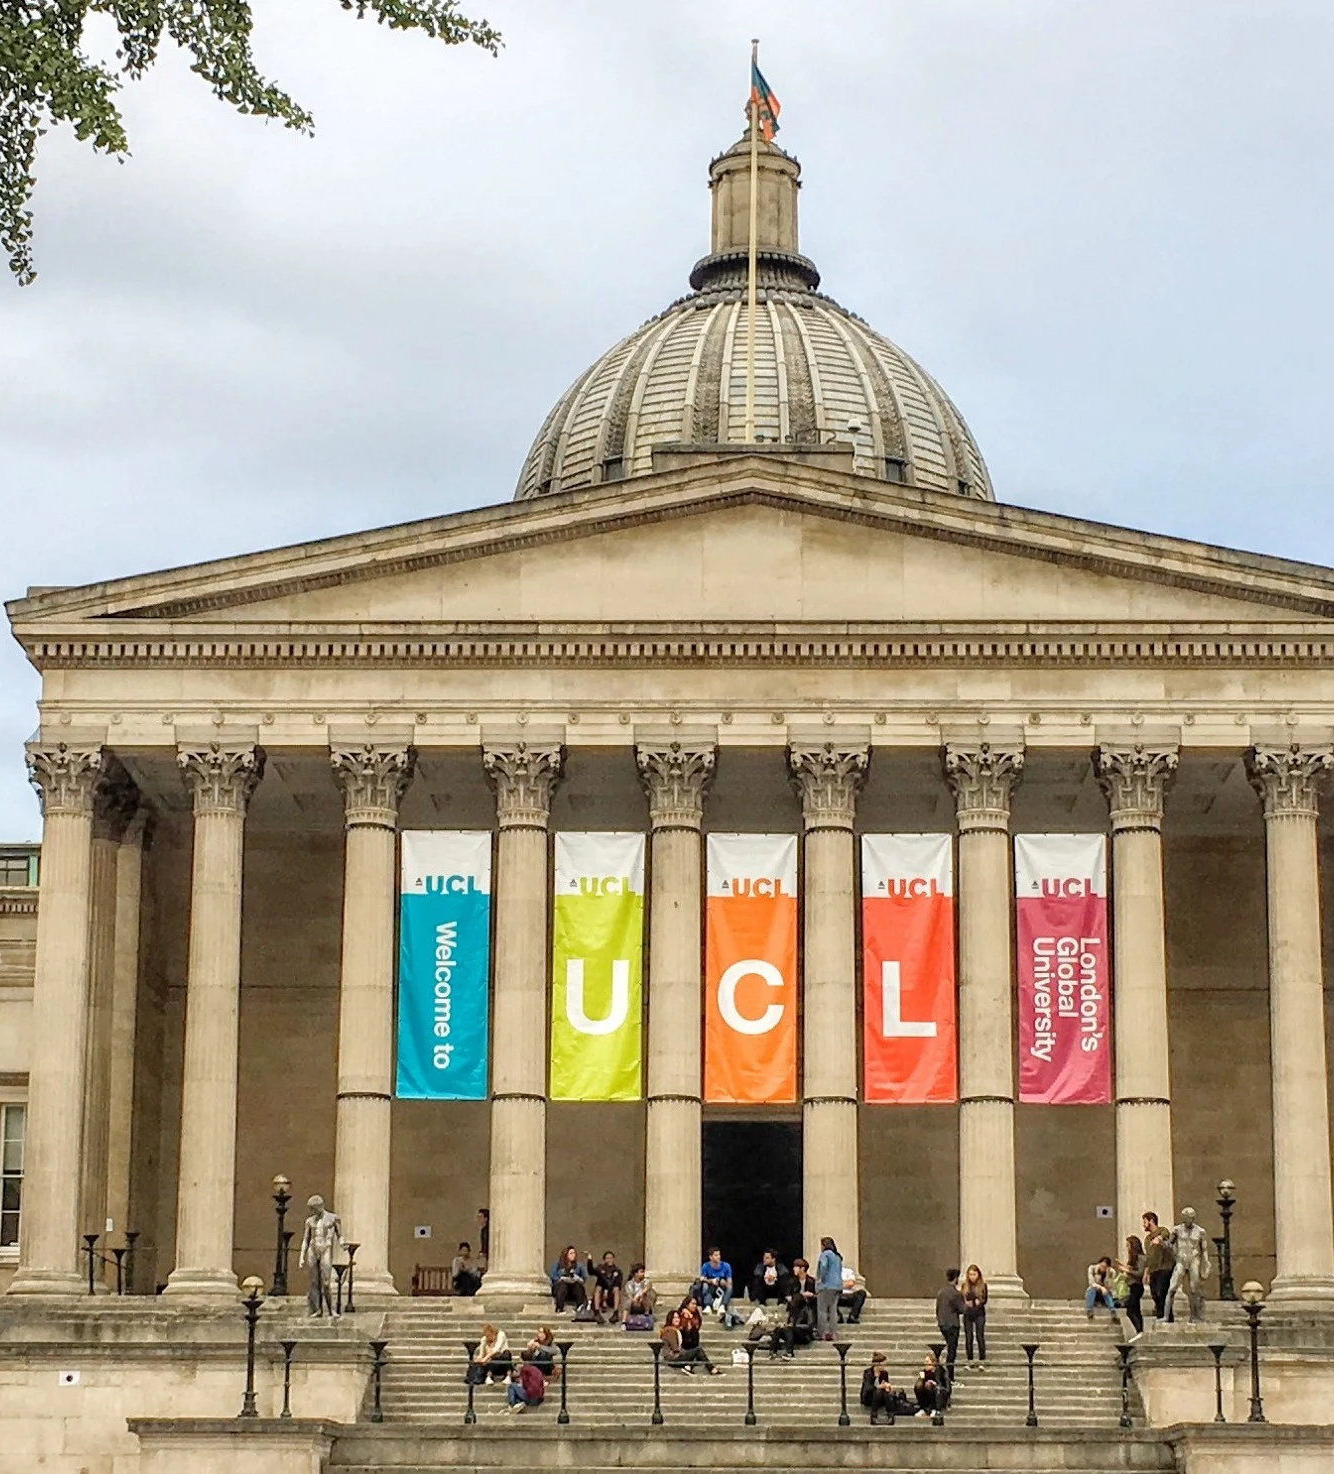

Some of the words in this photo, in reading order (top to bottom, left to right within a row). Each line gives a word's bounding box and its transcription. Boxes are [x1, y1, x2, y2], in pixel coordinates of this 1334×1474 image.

[425, 875, 482, 895] UCL
[579, 876, 636, 897] UCL
[732, 878, 789, 898] UCL
[887, 878, 945, 898] UCL
[1041, 878, 1098, 898] UCL
[434, 921, 458, 1037] Welcome
[1056, 936, 1079, 1018] Global
[566, 959, 630, 1036] U
[717, 959, 785, 1036] C
[881, 960, 938, 1038] L
[1030, 936, 1057, 1063] University
[433, 1043, 455, 1069] to
